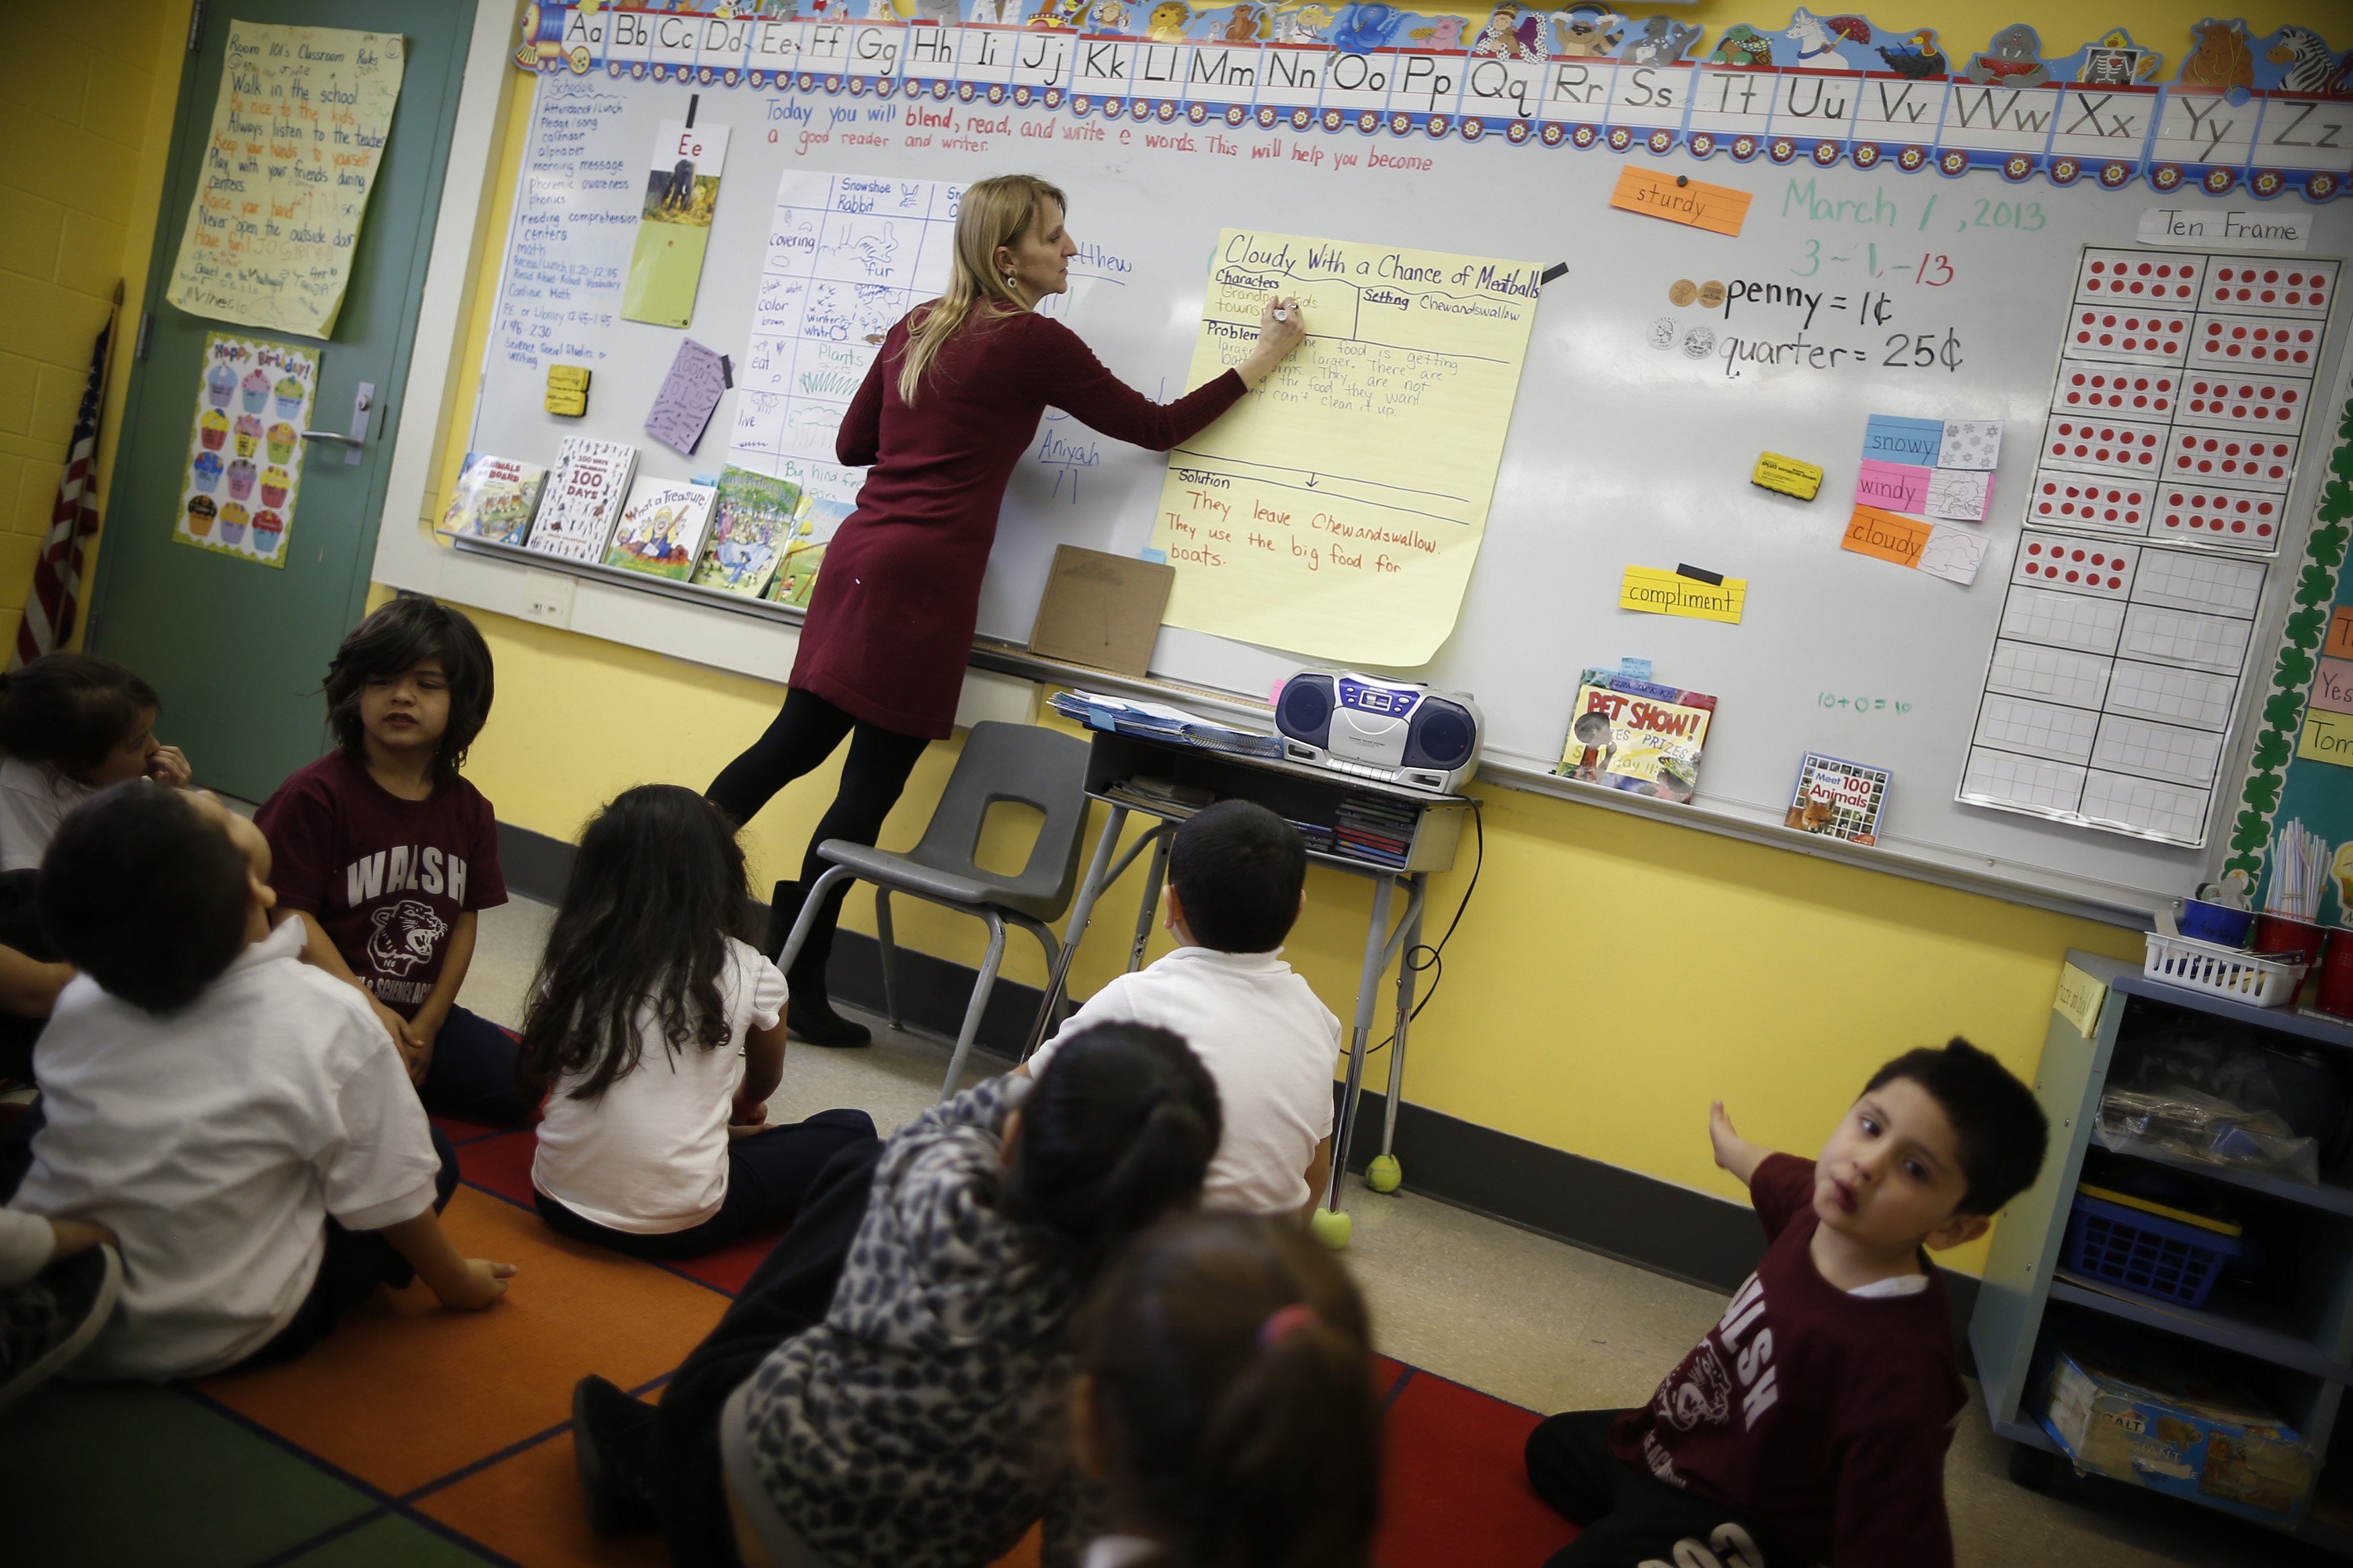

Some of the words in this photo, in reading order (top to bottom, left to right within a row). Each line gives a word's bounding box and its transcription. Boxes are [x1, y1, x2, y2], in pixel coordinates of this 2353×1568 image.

[230, 34, 260, 54] Room
[232, 71, 262, 95] Walk
[292, 78, 309, 99] the
[766, 99, 813, 126] Today
[829, 106, 857, 130] you
[868, 105, 895, 122] will
[1021, 122, 1053, 138] and
[1062, 120, 1106, 141] write
[1119, 126, 1131, 145] e
[1206, 136, 1238, 157] This
[1252, 138, 1281, 160] will
[1291, 142, 1324, 167] help
[1334, 152, 1357, 170] you
[1368, 145, 1433, 171] become
[768, 129, 778, 143] a
[795, 130, 829, 155] good
[842, 132, 889, 147] reader
[905, 134, 932, 147] and
[841, 177, 891, 194] Snowshoe
[837, 195, 874, 212] Rabbit
[1638, 184, 1706, 224] sturdy
[1782, 177, 1897, 226] March
[524, 226, 567, 241] centers
[2159, 210, 2204, 236] Ten
[2225, 212, 2299, 241] Frame
[867, 262, 894, 278] fur
[1215, 270, 1279, 288] Characters
[1226, 235, 1296, 278] Cloudy
[1309, 243, 1345, 274] With
[1356, 262, 1369, 275] a
[1378, 255, 1441, 283] Chance
[1451, 263, 1470, 285] of
[1479, 265, 1540, 299] Meatballs
[1363, 288, 1410, 311] Setting
[1725, 280, 1823, 329] penny
[752, 354, 770, 370] eat
[819, 343, 863, 367] Plants
[1337, 341, 1366, 356] food
[1380, 349, 1391, 358] is
[1407, 353, 1458, 375] getting
[1319, 366, 1347, 384] They
[1367, 376, 1388, 387] are
[1404, 380, 1431, 392] not
[1367, 359, 1406, 376] There
[1421, 370, 1442, 380] are
[1280, 375, 1298, 386] the
[1308, 376, 1333, 393] food
[1345, 383, 1372, 402] they
[1321, 395, 1351, 409] clean
[1360, 400, 1371, 411] it
[739, 409, 755, 427] live
[1038, 429, 1100, 469] Aniyah
[1872, 435, 1936, 464] snowy
[571, 470, 602, 487] 100
[785, 460, 804, 487] Big
[813, 464, 838, 481] hind
[1178, 470, 1230, 489] Solution
[567, 486, 598, 499] DAYS
[1860, 475, 1916, 511] windy
[1187, 491, 1231, 522] They
[1253, 499, 1291, 526] leave
[1166, 512, 1196, 539] They
[1209, 527, 1231, 542] use
[1248, 532, 1275, 551] the
[1292, 534, 1319, 570] big
[1329, 544, 1362, 569] food
[1375, 554, 1402, 573] for
[1171, 543, 1226, 567] boats.
[1853, 519, 1921, 565] cloudy
[1629, 583, 1734, 612] compliment
[1588, 692, 1630, 721] PET
[1628, 702, 1701, 742] SHOW!
[1642, 734, 1688, 759] PRIZES
[1810, 784, 1868, 808] Animals
[1816, 773, 1841, 785] Meet
[1843, 776, 1870, 794] 100
[347, 844, 467, 908] WALSH
